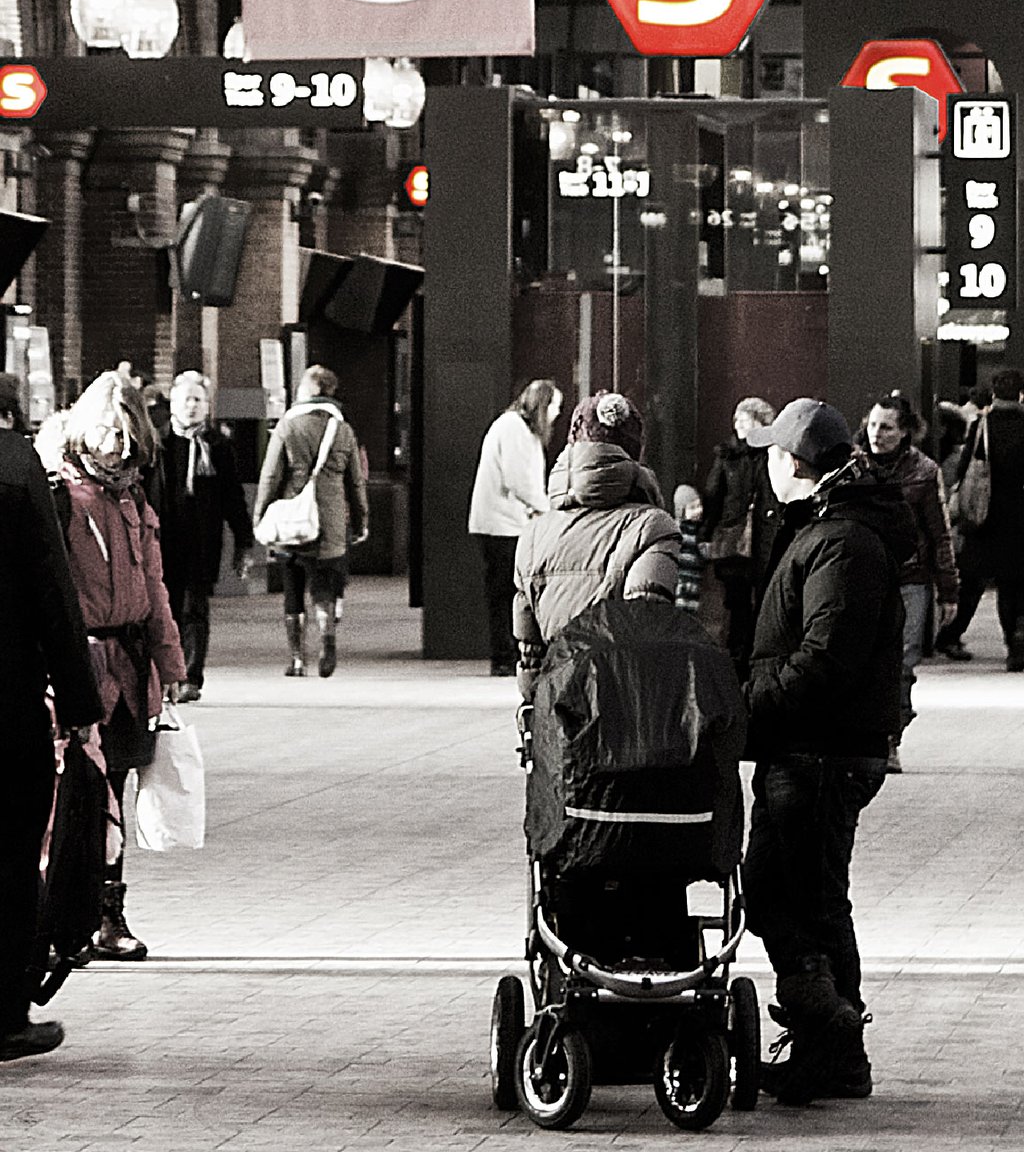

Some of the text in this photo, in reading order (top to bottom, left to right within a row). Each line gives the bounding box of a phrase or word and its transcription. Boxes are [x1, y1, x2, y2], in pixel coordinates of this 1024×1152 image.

[1, 72, 37, 111] S
[269, 72, 357, 107] 9-10
[968, 213, 995, 249] 9
[959, 262, 1007, 298] 10
